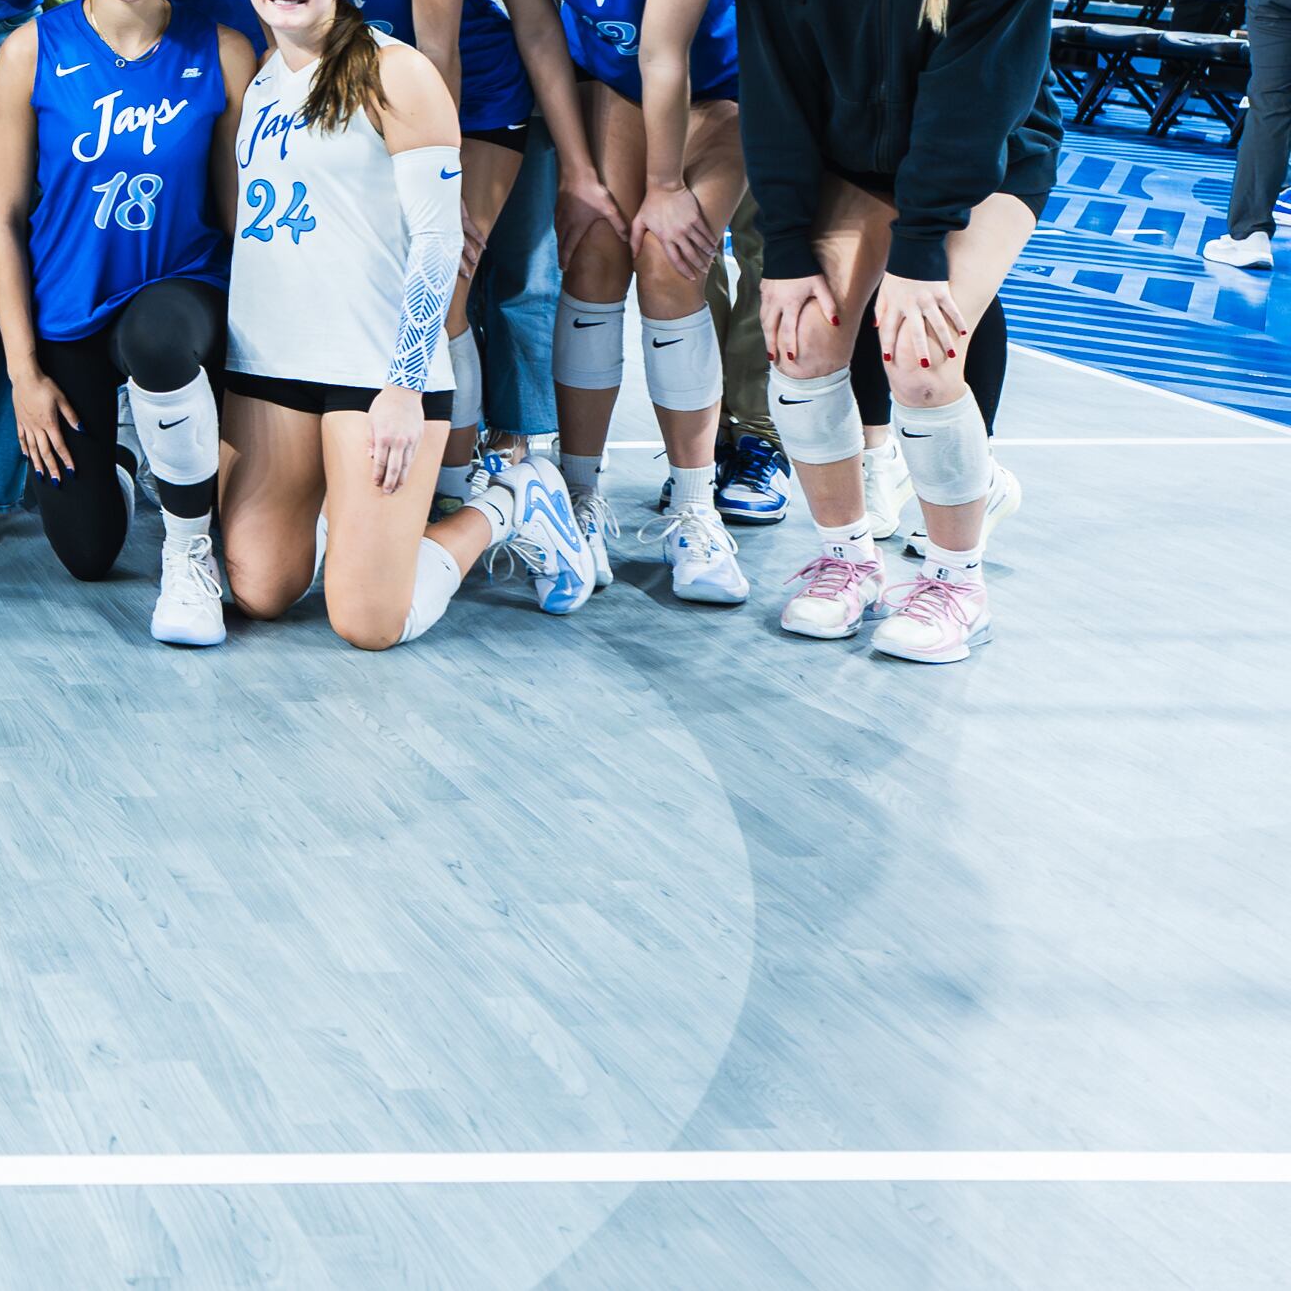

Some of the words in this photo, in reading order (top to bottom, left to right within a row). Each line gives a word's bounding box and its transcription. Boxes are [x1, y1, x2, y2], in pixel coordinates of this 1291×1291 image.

[72, 90, 189, 162] Jays
[237, 100, 316, 168] Jays
[92, 171, 164, 231] 18
[241, 179, 317, 245] 24
